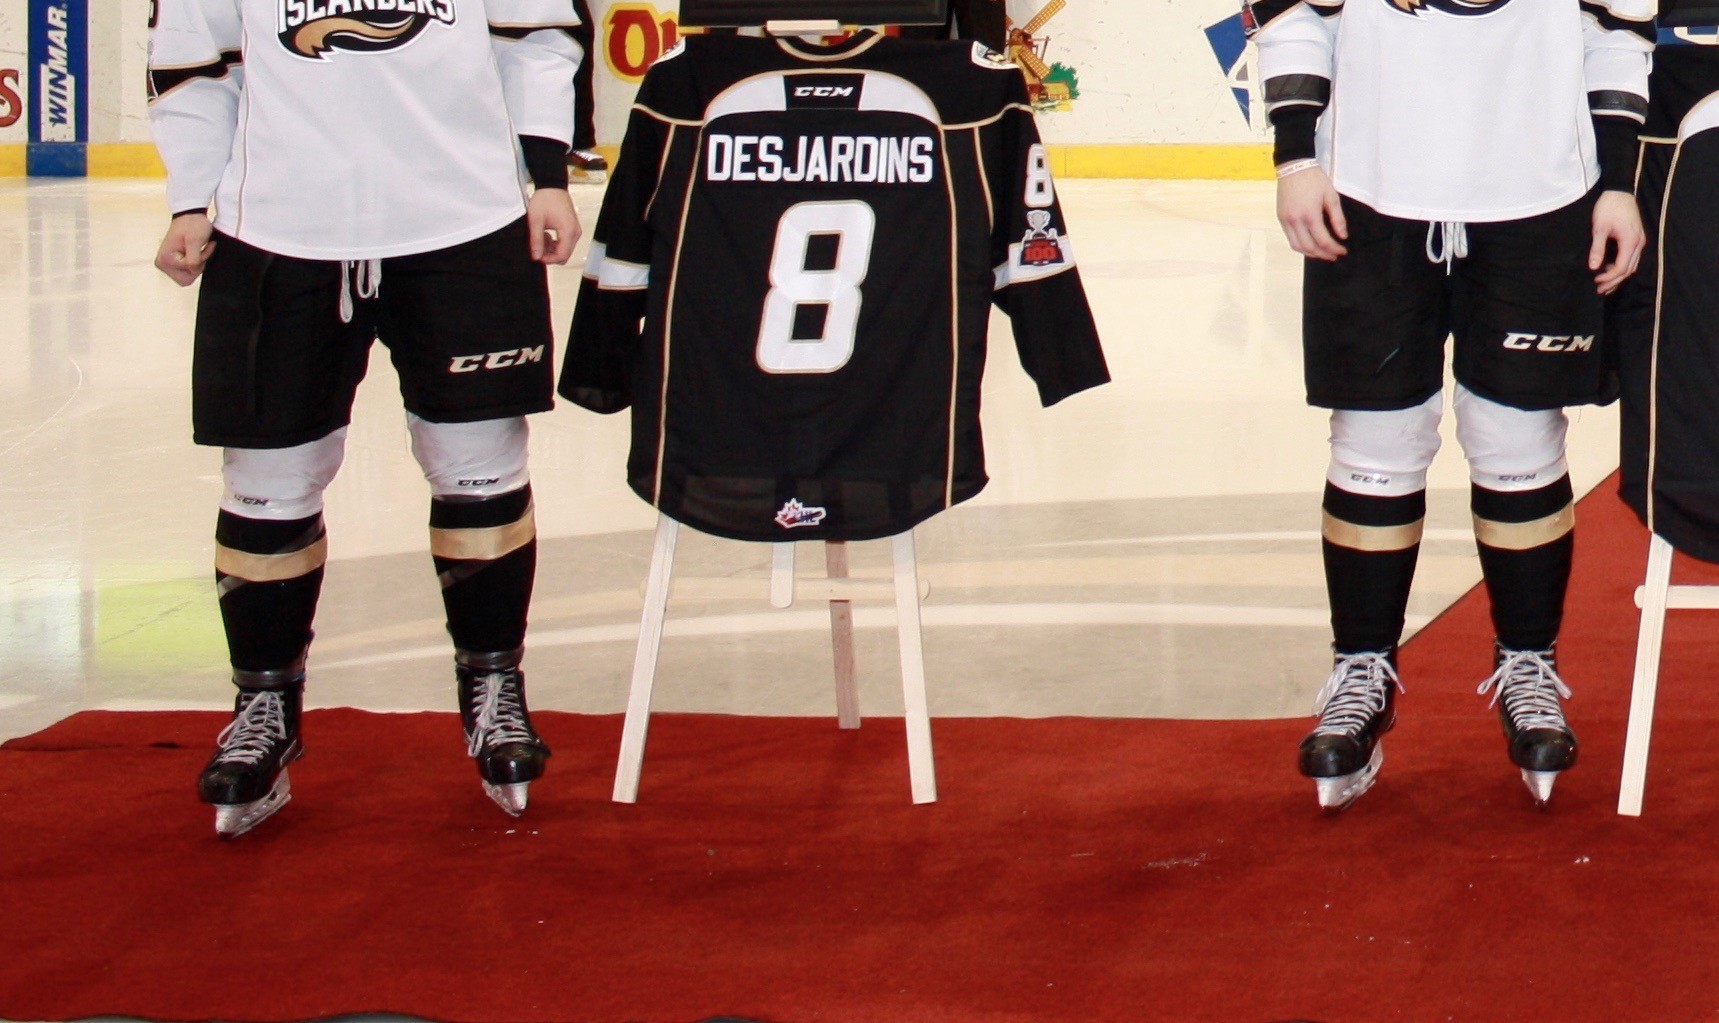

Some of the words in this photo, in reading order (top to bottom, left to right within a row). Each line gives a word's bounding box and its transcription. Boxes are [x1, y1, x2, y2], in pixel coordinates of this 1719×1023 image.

[793, 85, 853, 98] CCM
[706, 134, 934, 184] DESJARDINS
[1024, 143, 1054, 208] 8
[755, 199, 876, 374] 8
[1502, 332, 1595, 352] CCM
[448, 344, 545, 374] CCM
[457, 478, 500, 487] CCM
[1349, 473, 1390, 487] CCM
[1498, 473, 1538, 484] CCM
